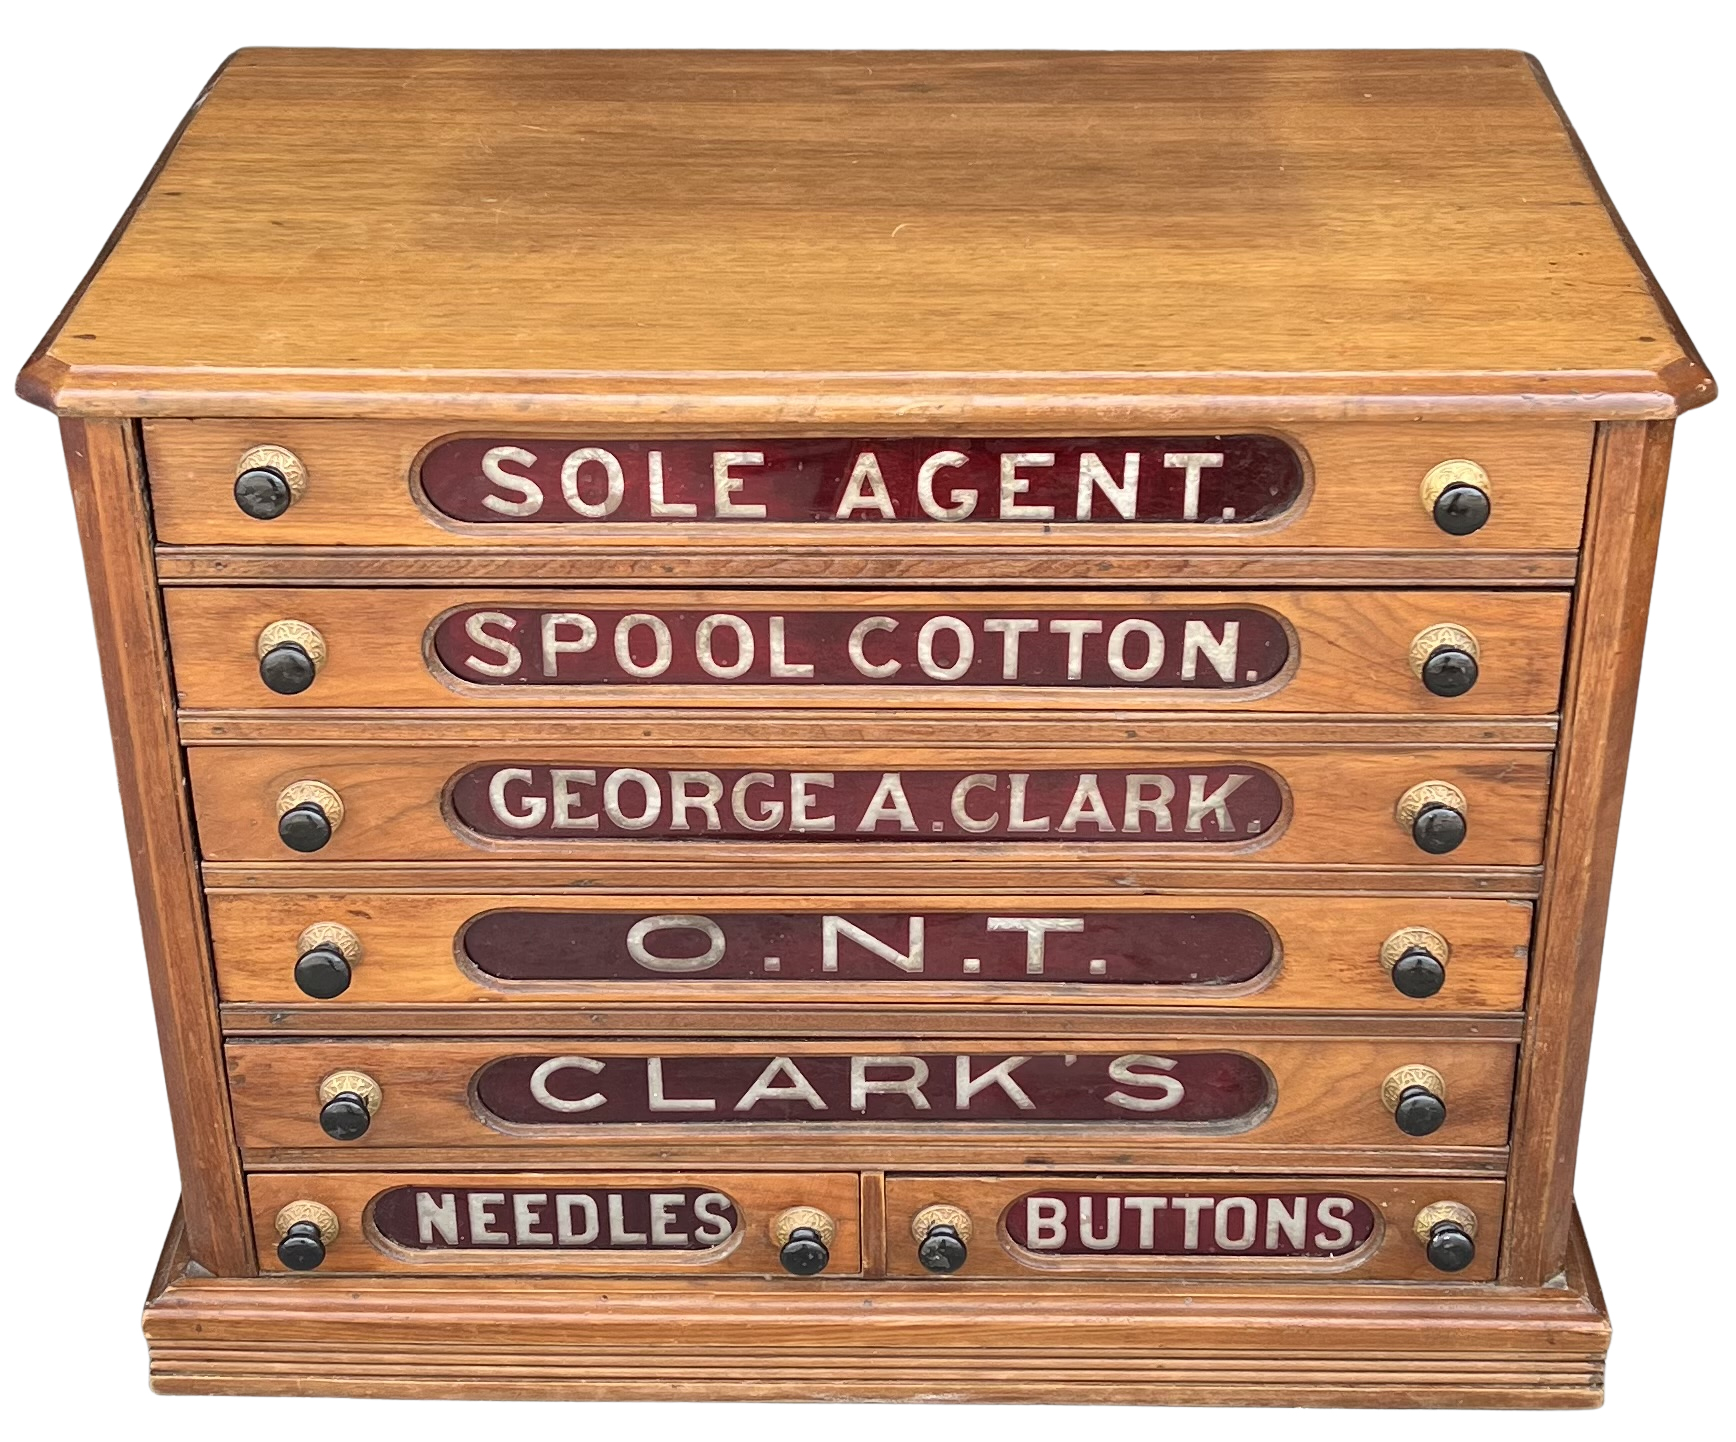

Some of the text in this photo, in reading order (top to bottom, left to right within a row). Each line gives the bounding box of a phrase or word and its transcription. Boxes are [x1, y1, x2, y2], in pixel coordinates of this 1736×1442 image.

[480, 446, 1237, 522] SOLE AGENT.
[464, 611, 1259, 684] SPOOL COTTON.
[488, 768, 837, 832] GEORGE
[530, 1055, 1185, 1113] CLARK'S
[415, 1192, 733, 1246] NEEDLES
[1026, 1196, 1355, 1250] BUTTONS
